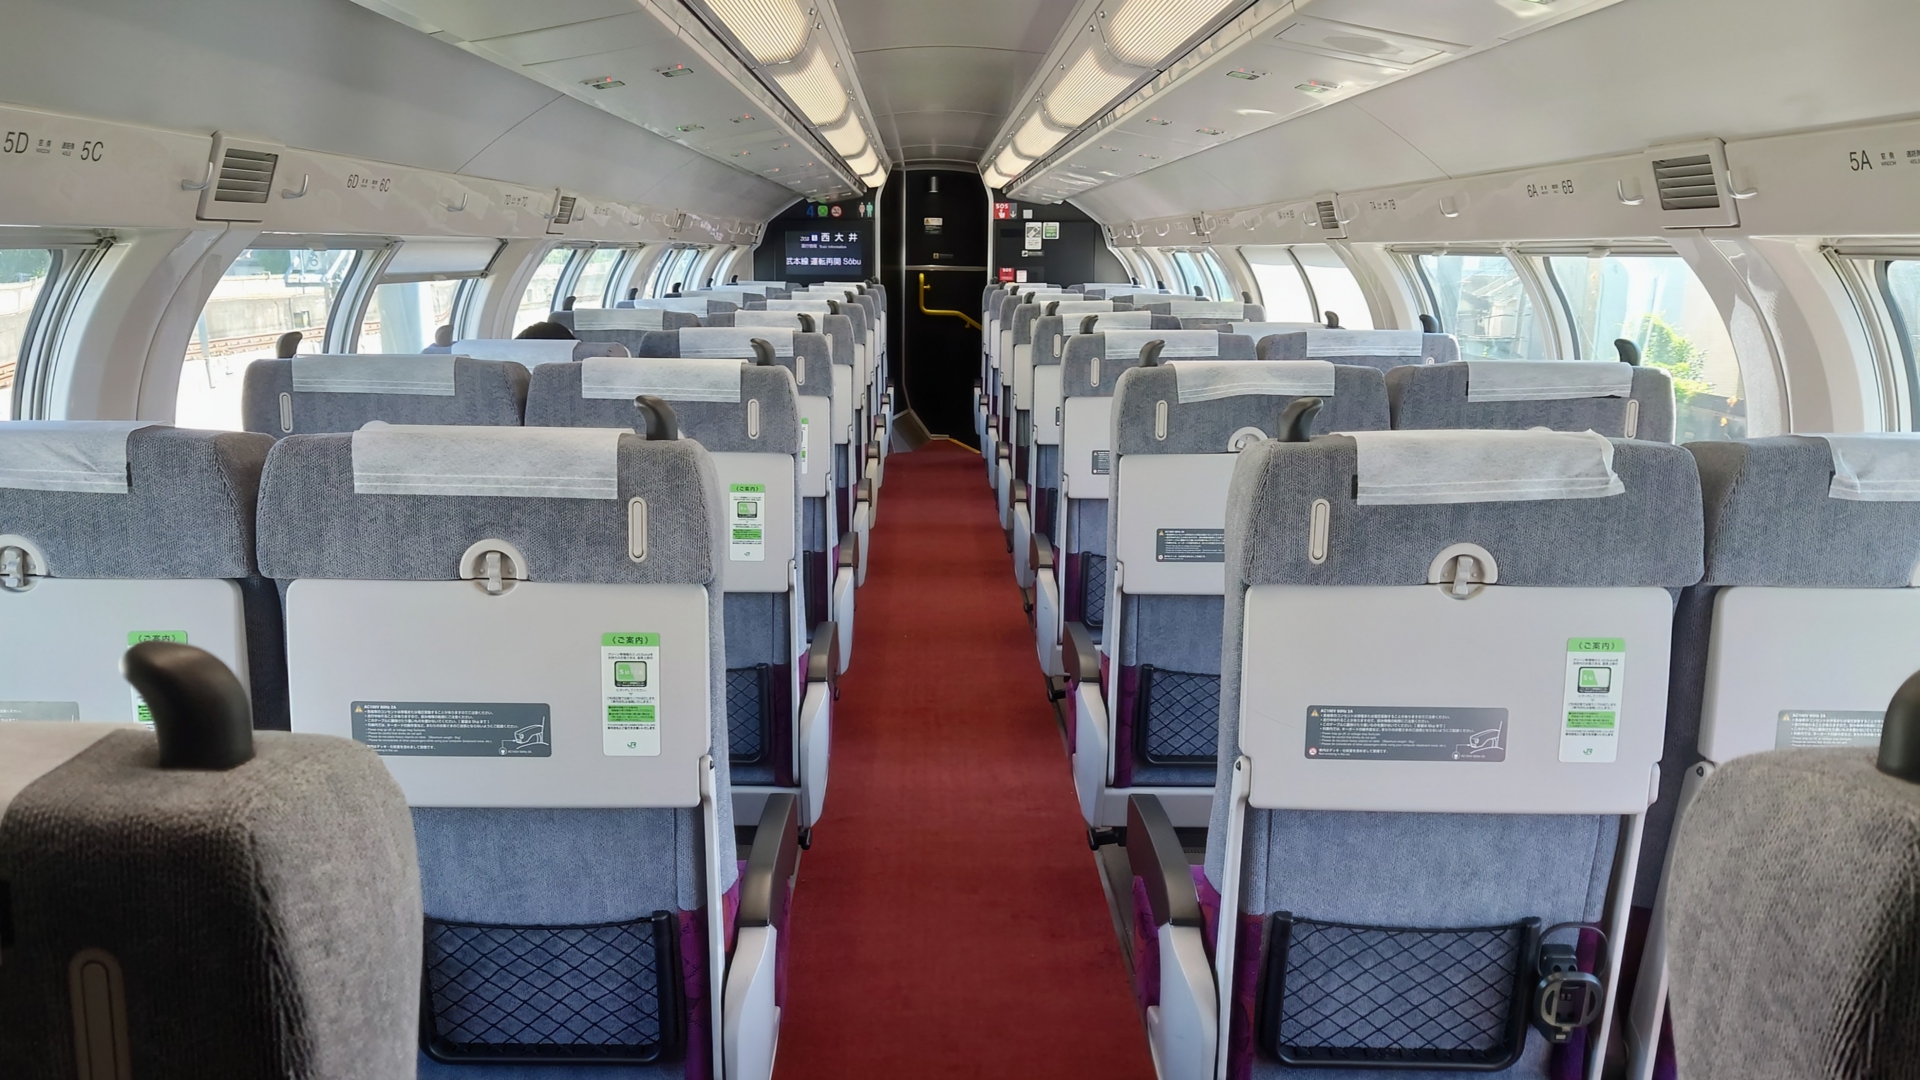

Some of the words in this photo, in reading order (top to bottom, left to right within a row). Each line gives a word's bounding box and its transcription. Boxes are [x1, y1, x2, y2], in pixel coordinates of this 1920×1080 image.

[3, 131, 29, 154] 5D
[80, 141, 104, 162] 5C
[1849, 149, 1873, 172] 5A
[347, 174, 359, 189] 6D
[379, 178, 391, 192] 6C
[1561, 179, 1575, 195] 6B
[1526, 183, 1539, 198] 6A
[806, 205, 815, 218] 4
[820, 232, 858, 242] 西大井
